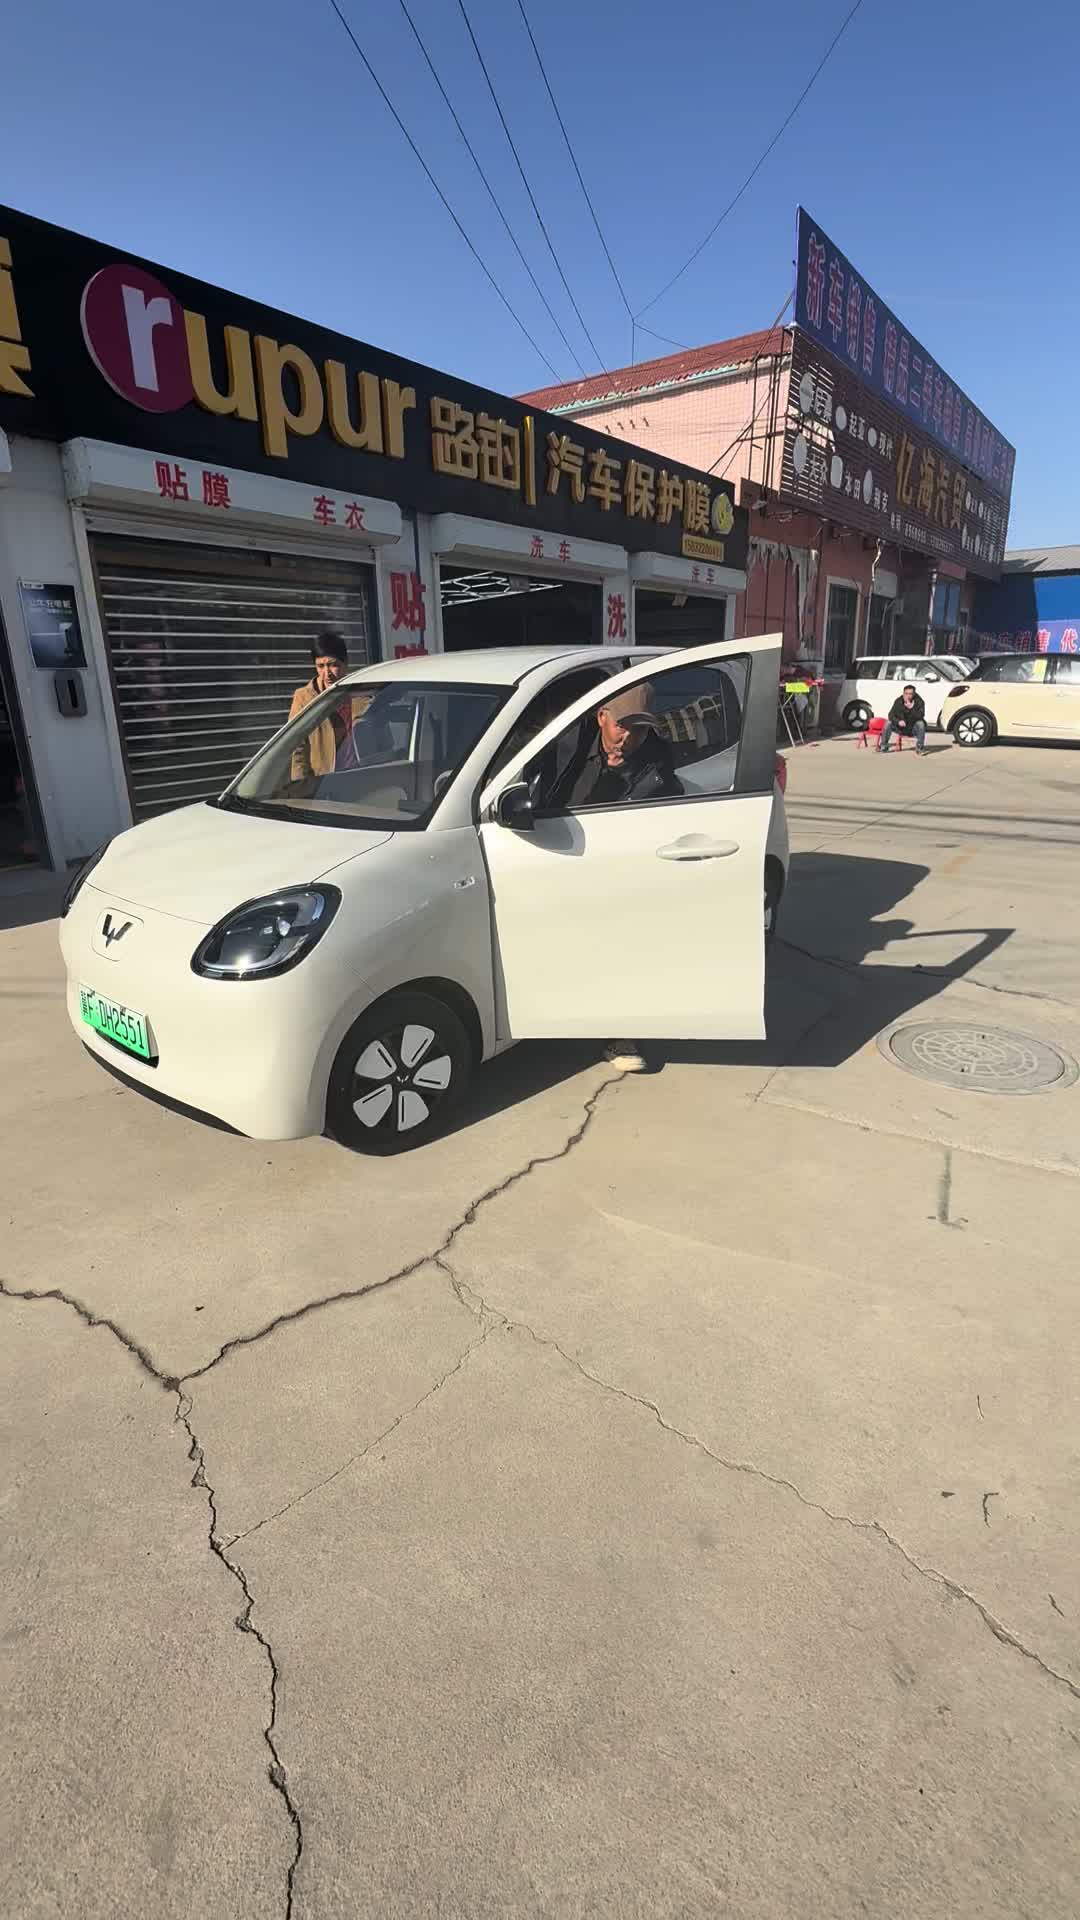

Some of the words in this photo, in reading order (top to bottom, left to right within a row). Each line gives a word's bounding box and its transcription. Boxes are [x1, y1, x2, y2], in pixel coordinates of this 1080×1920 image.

[121, 283, 417, 460] rupur
[153, 460, 232, 510] 贴膜
[312, 495, 367, 532] 车衣
[545, 430, 712, 535] 汽车保护膜
[529, 534, 573, 564] 洗车
